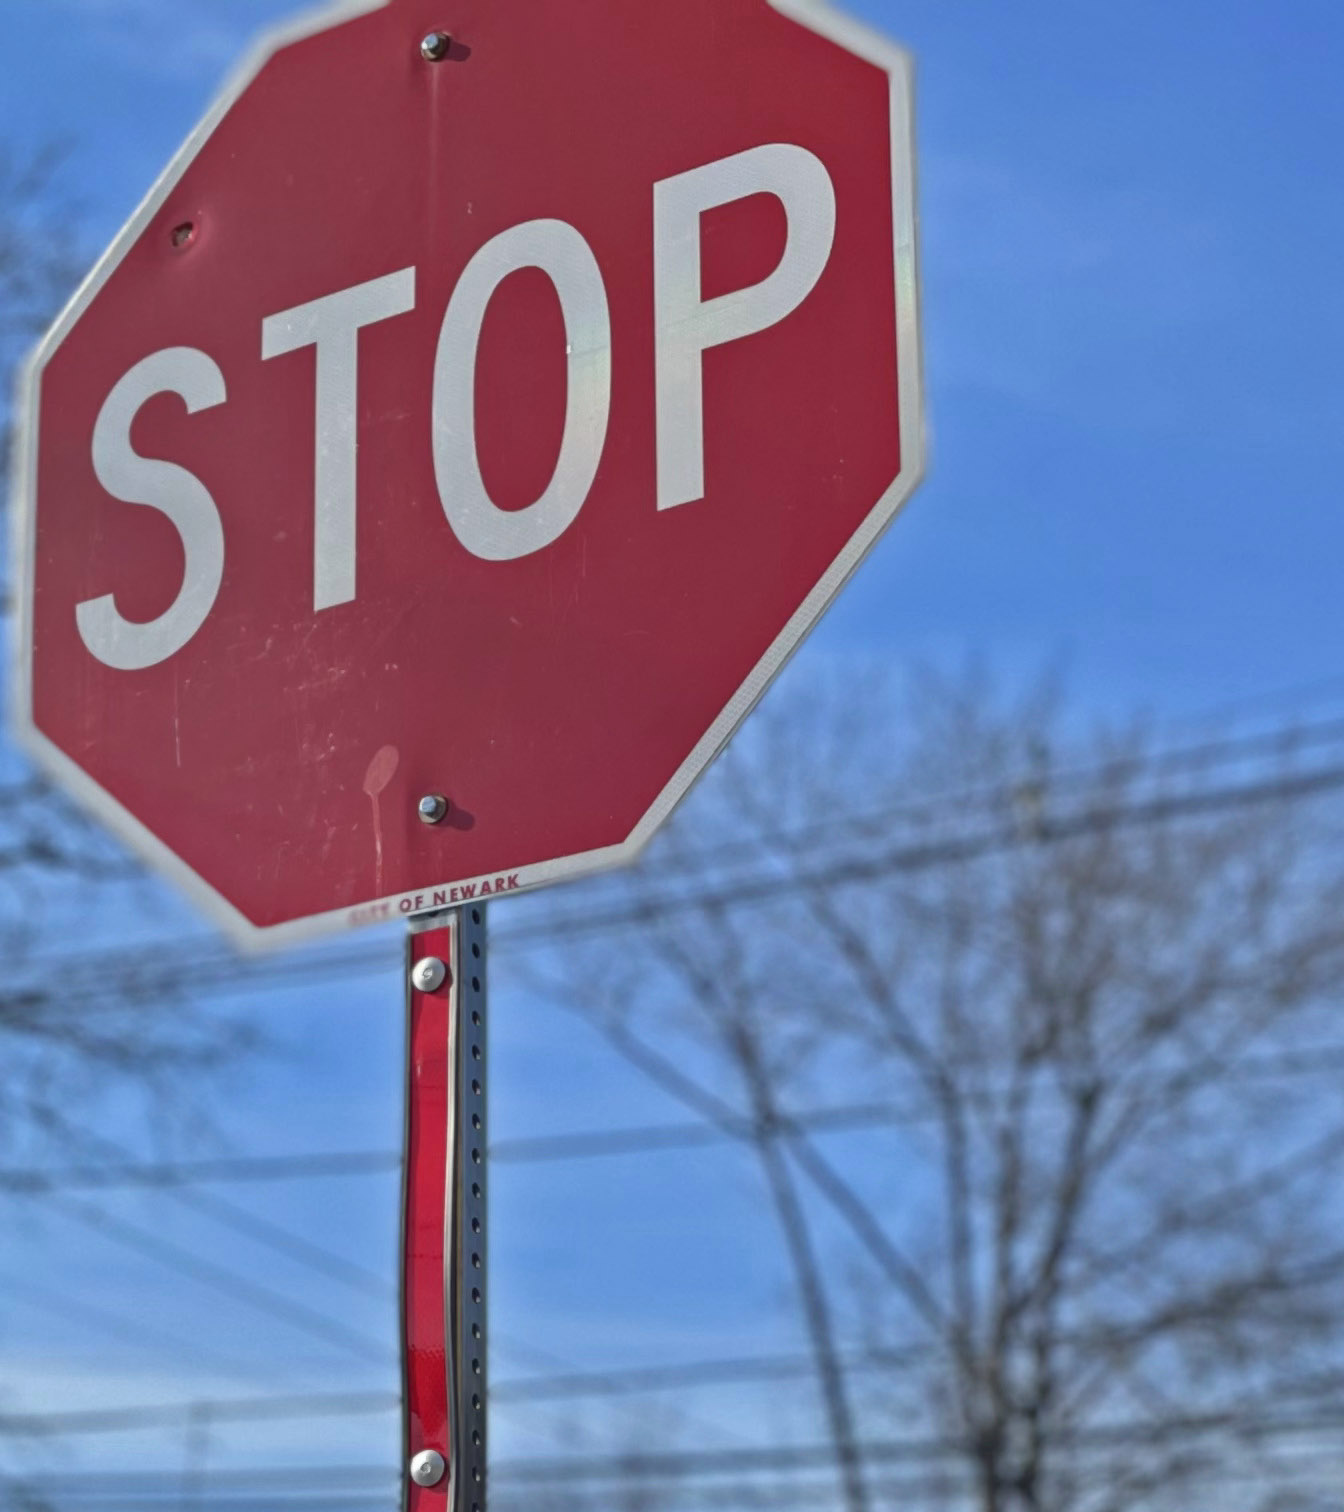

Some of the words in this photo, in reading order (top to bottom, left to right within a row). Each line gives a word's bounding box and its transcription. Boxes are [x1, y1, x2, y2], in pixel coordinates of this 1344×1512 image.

[75, 143, 837, 671] STOP
[399, 896, 425, 913] OF
[433, 873, 520, 905] NEWARK
